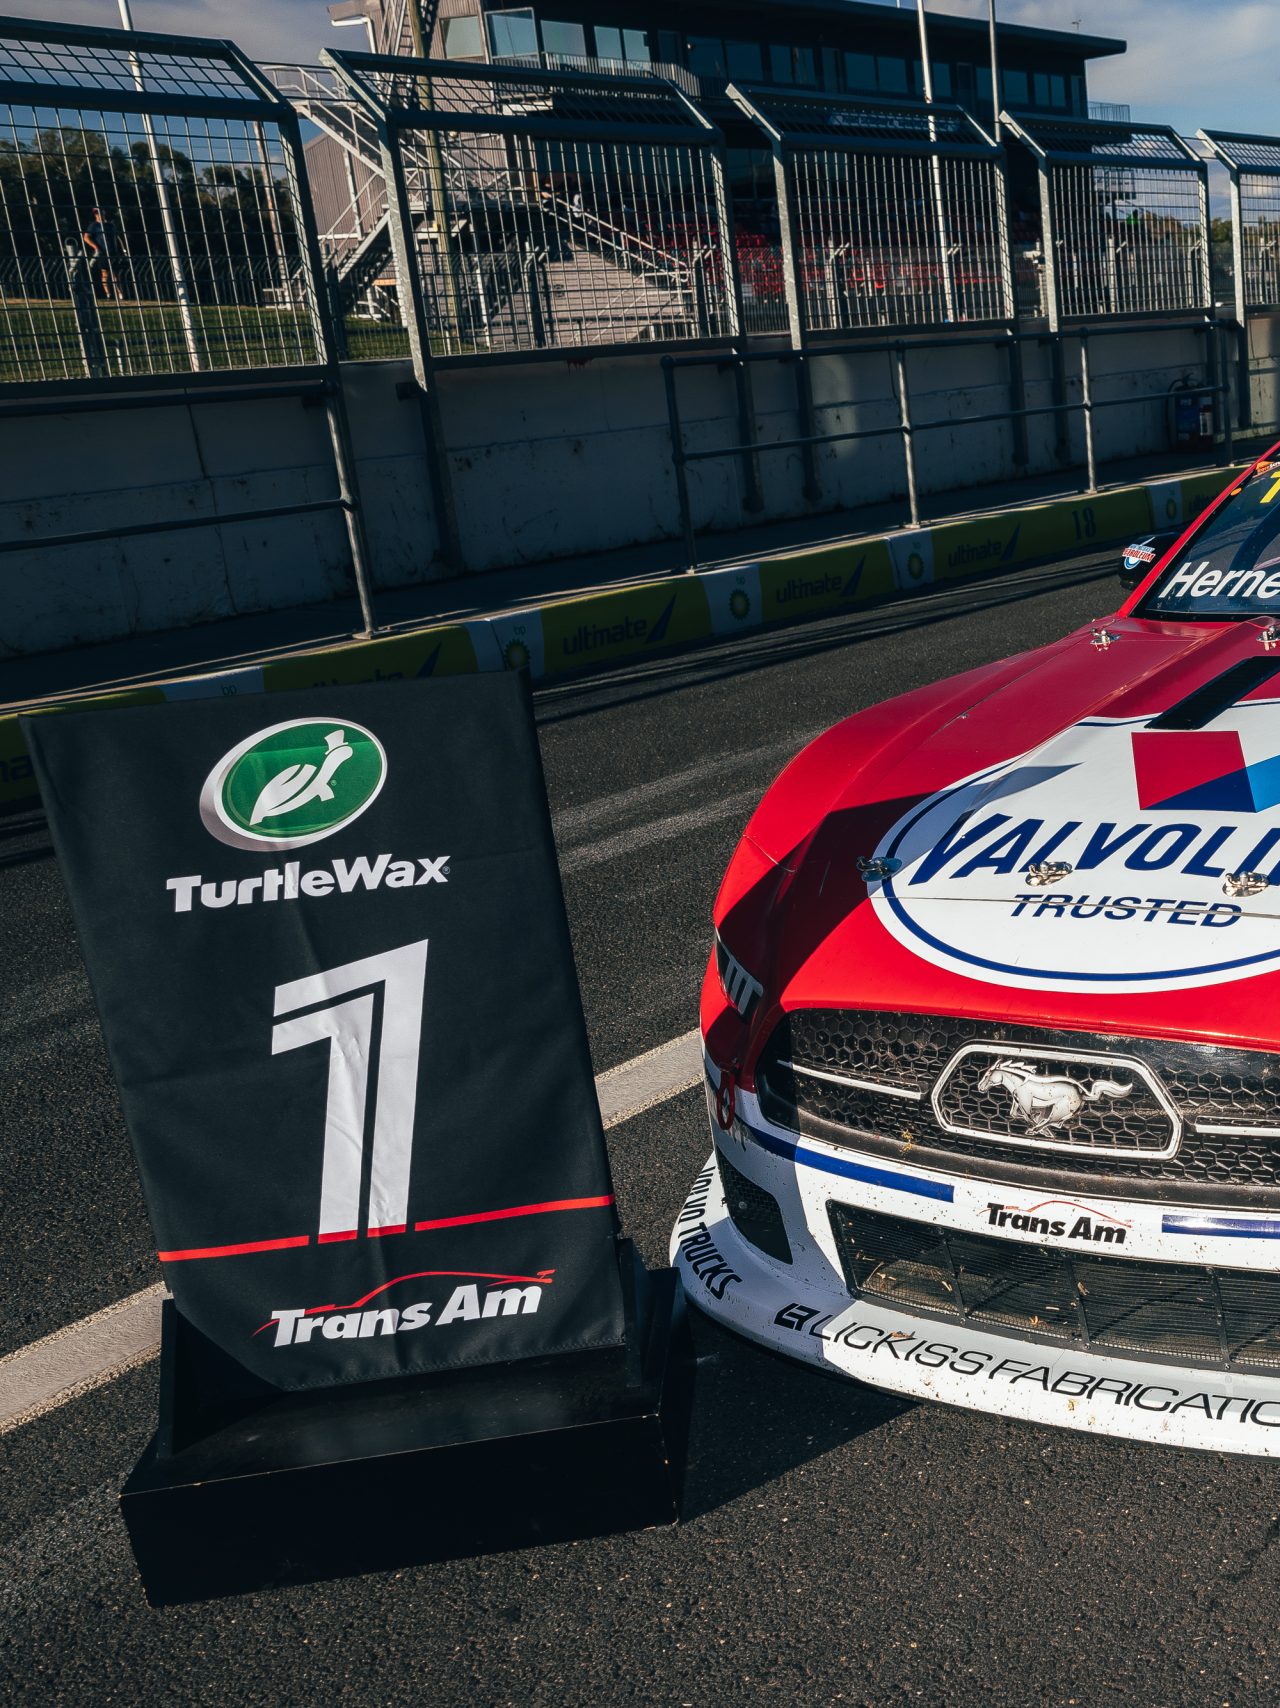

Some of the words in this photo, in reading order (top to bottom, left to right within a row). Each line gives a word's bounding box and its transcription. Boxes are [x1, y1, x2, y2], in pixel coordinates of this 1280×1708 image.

[1072, 506, 1097, 539] 18
[947, 537, 1003, 568] ultimate
[775, 572, 843, 605] ultimate
[562, 615, 648, 656] ultimate
[166, 853, 448, 913] TurtleWax
[1010, 893, 1242, 929] TRUSTED
[271, 938, 430, 1245] 1
[986, 1202, 1068, 1238] Trans
[1068, 1216, 1127, 1245] Am
[677, 1221, 744, 1301] TRUCKS
[271, 1300, 432, 1348] Trans
[433, 1283, 543, 1328] Am
[808, 1314, 993, 1376] LICKISS
